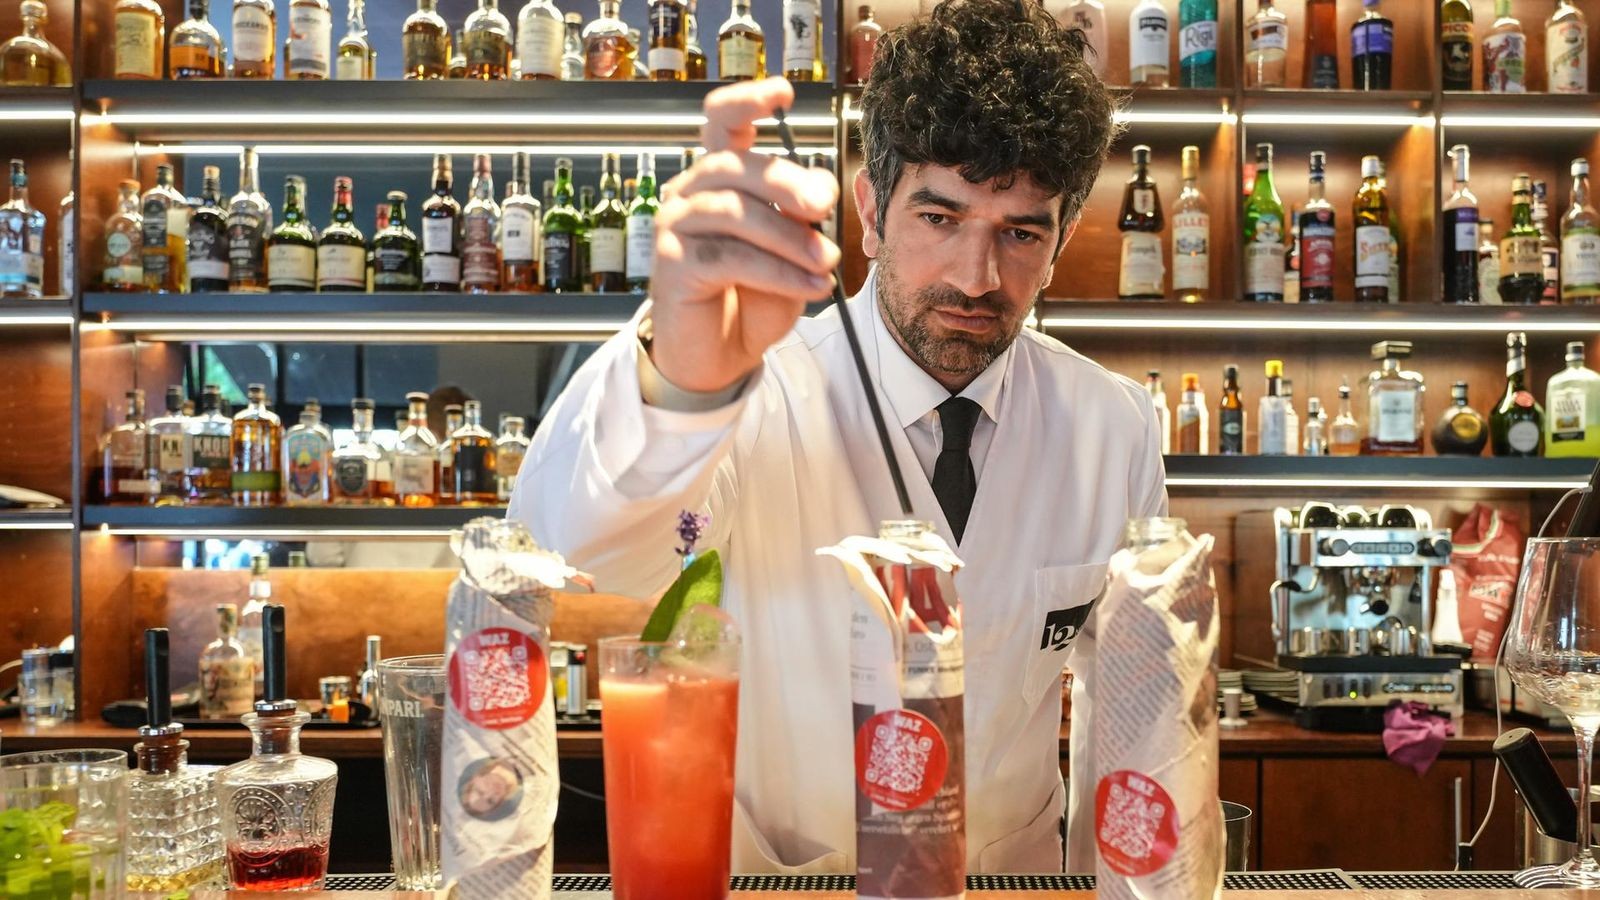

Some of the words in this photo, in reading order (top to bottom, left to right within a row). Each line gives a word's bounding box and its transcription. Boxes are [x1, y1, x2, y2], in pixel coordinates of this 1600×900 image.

[1185, 26, 1213, 48] Rigi
[479, 632, 511, 647] WAZ
[894, 714, 923, 733] WAZ
[1127, 774, 1155, 797] WAZ
